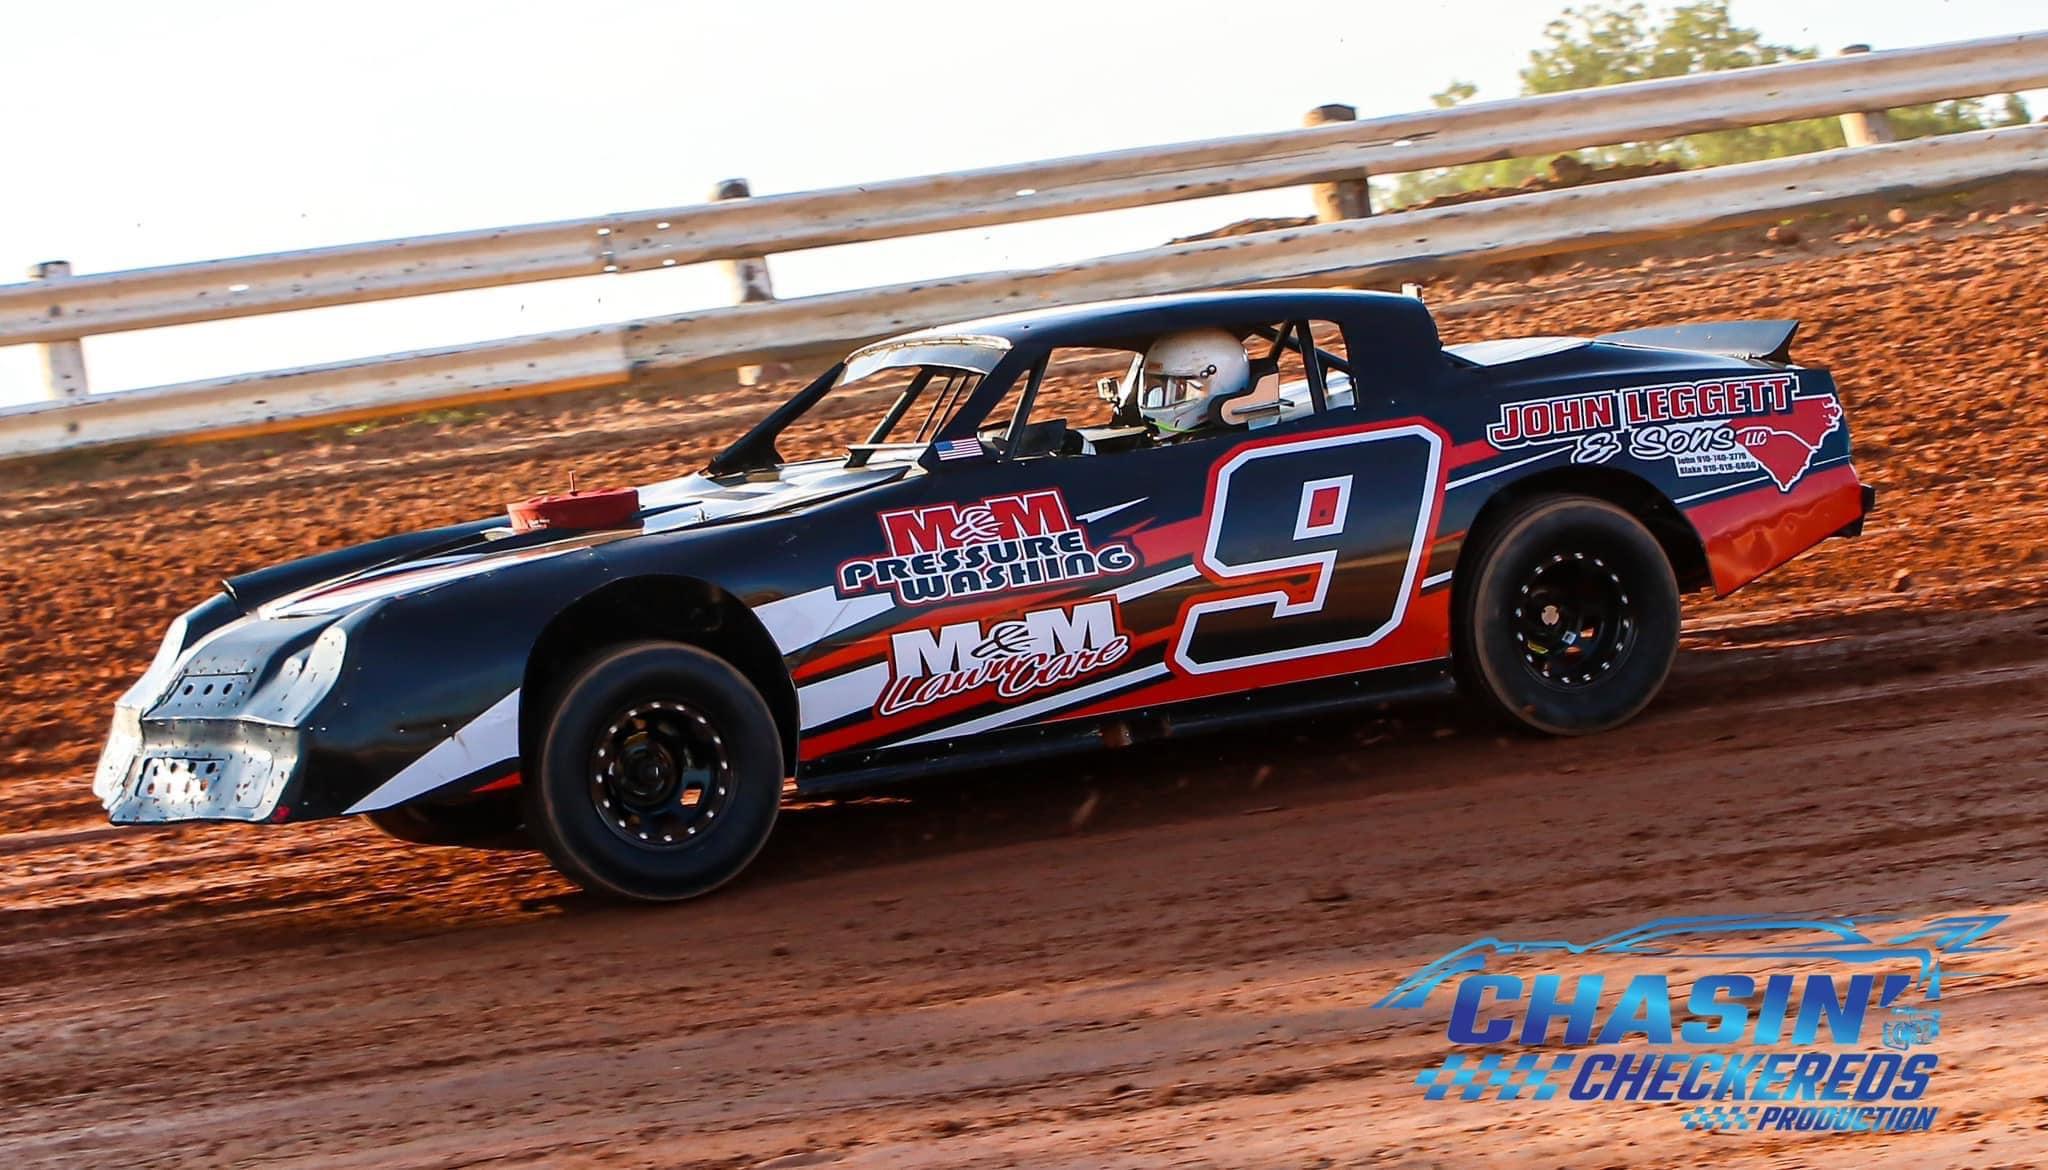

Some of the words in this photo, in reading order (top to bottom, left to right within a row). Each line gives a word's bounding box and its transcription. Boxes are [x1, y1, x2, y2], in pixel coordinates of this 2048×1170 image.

[1491, 391, 1614, 443] JOHN
[1625, 377, 1792, 424] LEGGETT
[1577, 432, 1620, 463] &
[1631, 426, 1736, 458] Sons
[881, 490, 1072, 557] M&M
[1172, 423, 1444, 676] 9
[841, 529, 1086, 590] PRESSURE
[899, 544, 1136, 605] WASHING
[892, 600, 1119, 678] M&M
[880, 652, 1022, 716] Lawn
[997, 635, 1129, 698] Care
